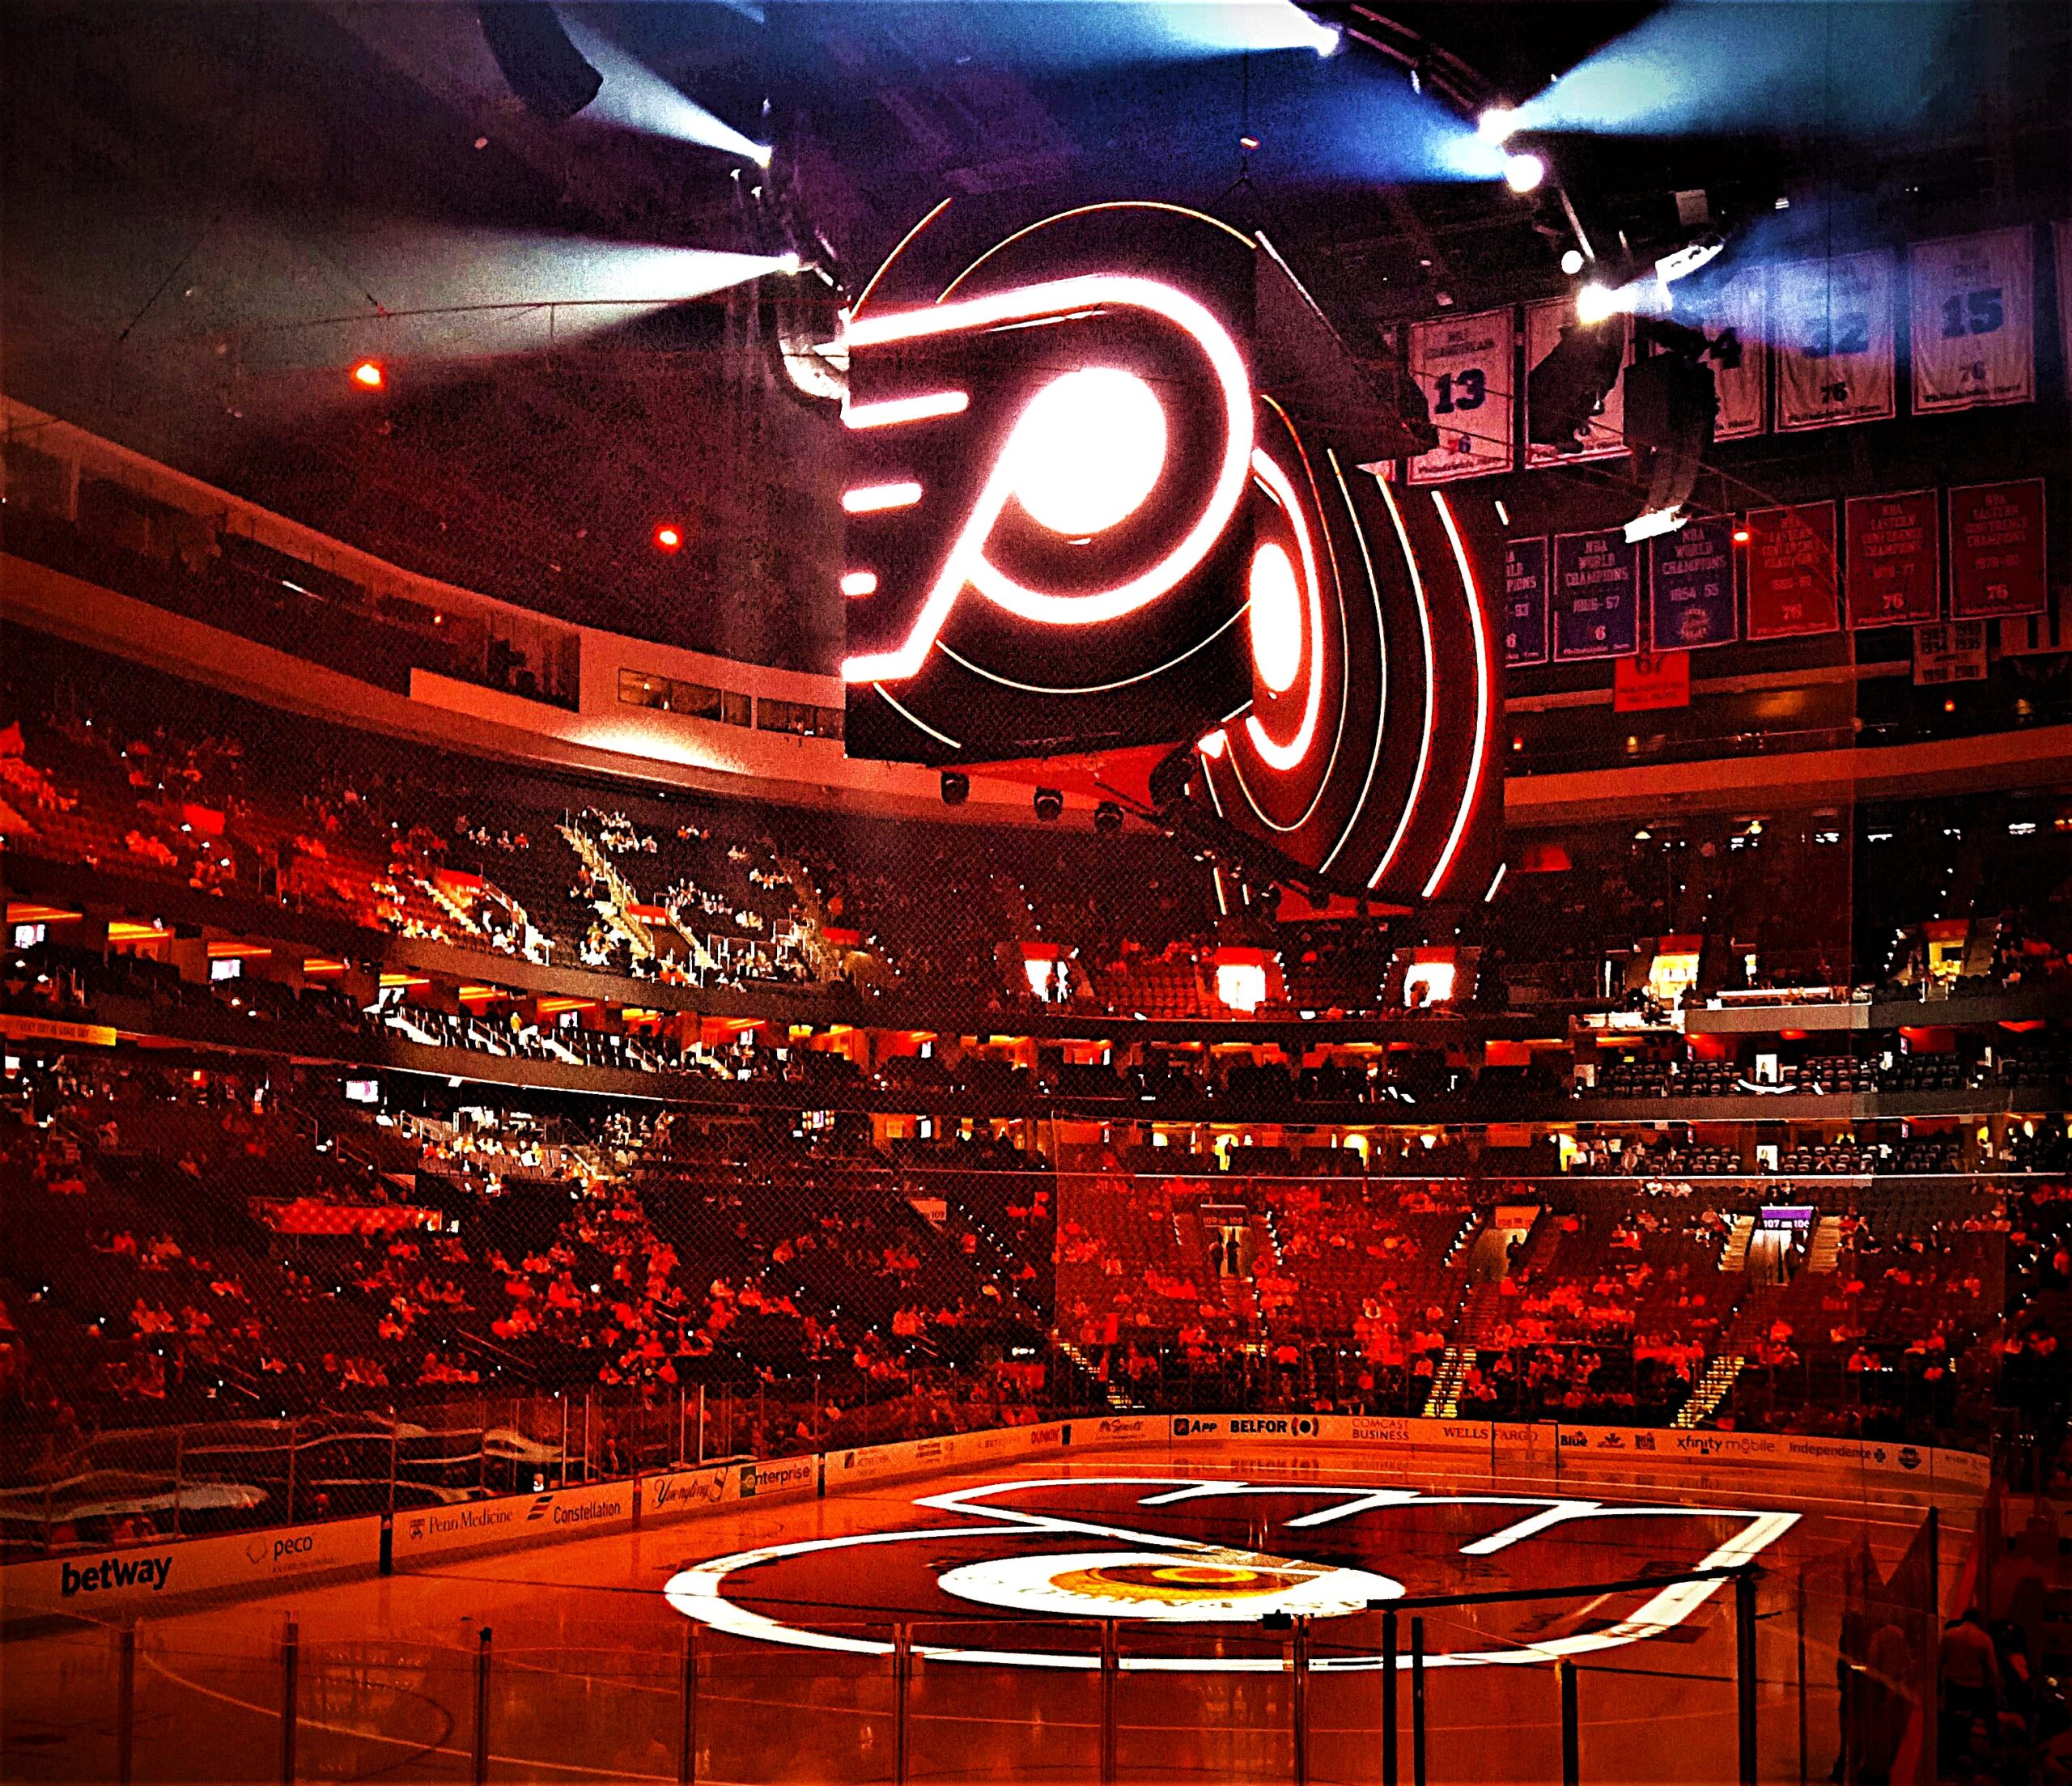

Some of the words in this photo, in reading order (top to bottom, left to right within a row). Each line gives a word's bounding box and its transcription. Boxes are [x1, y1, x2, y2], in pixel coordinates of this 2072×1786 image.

[1942, 287, 2003, 341] 15
[1434, 369, 1485, 414] 13
[1820, 382, 1845, 404] 76
[1229, 1419, 1288, 1433] BELFOR
[1352, 1417, 1409, 1430] COMCAST
[1352, 1428, 1410, 1441] BUSINESS
[1442, 1426, 1489, 1440] WELLS
[1494, 1429, 1538, 1441] FARGO
[1560, 1435, 1588, 1447] Blue
[1677, 1435, 1722, 1452] xfinity
[1790, 1441, 1871, 1460] Independence
[743, 1465, 810, 1489] enterprise
[430, 1516, 459, 1534] Penn
[461, 1507, 513, 1529] Medicine
[554, 1501, 621, 1525] Constellation
[274, 1537, 313, 1562] peco
[61, 1556, 172, 1597] betway
